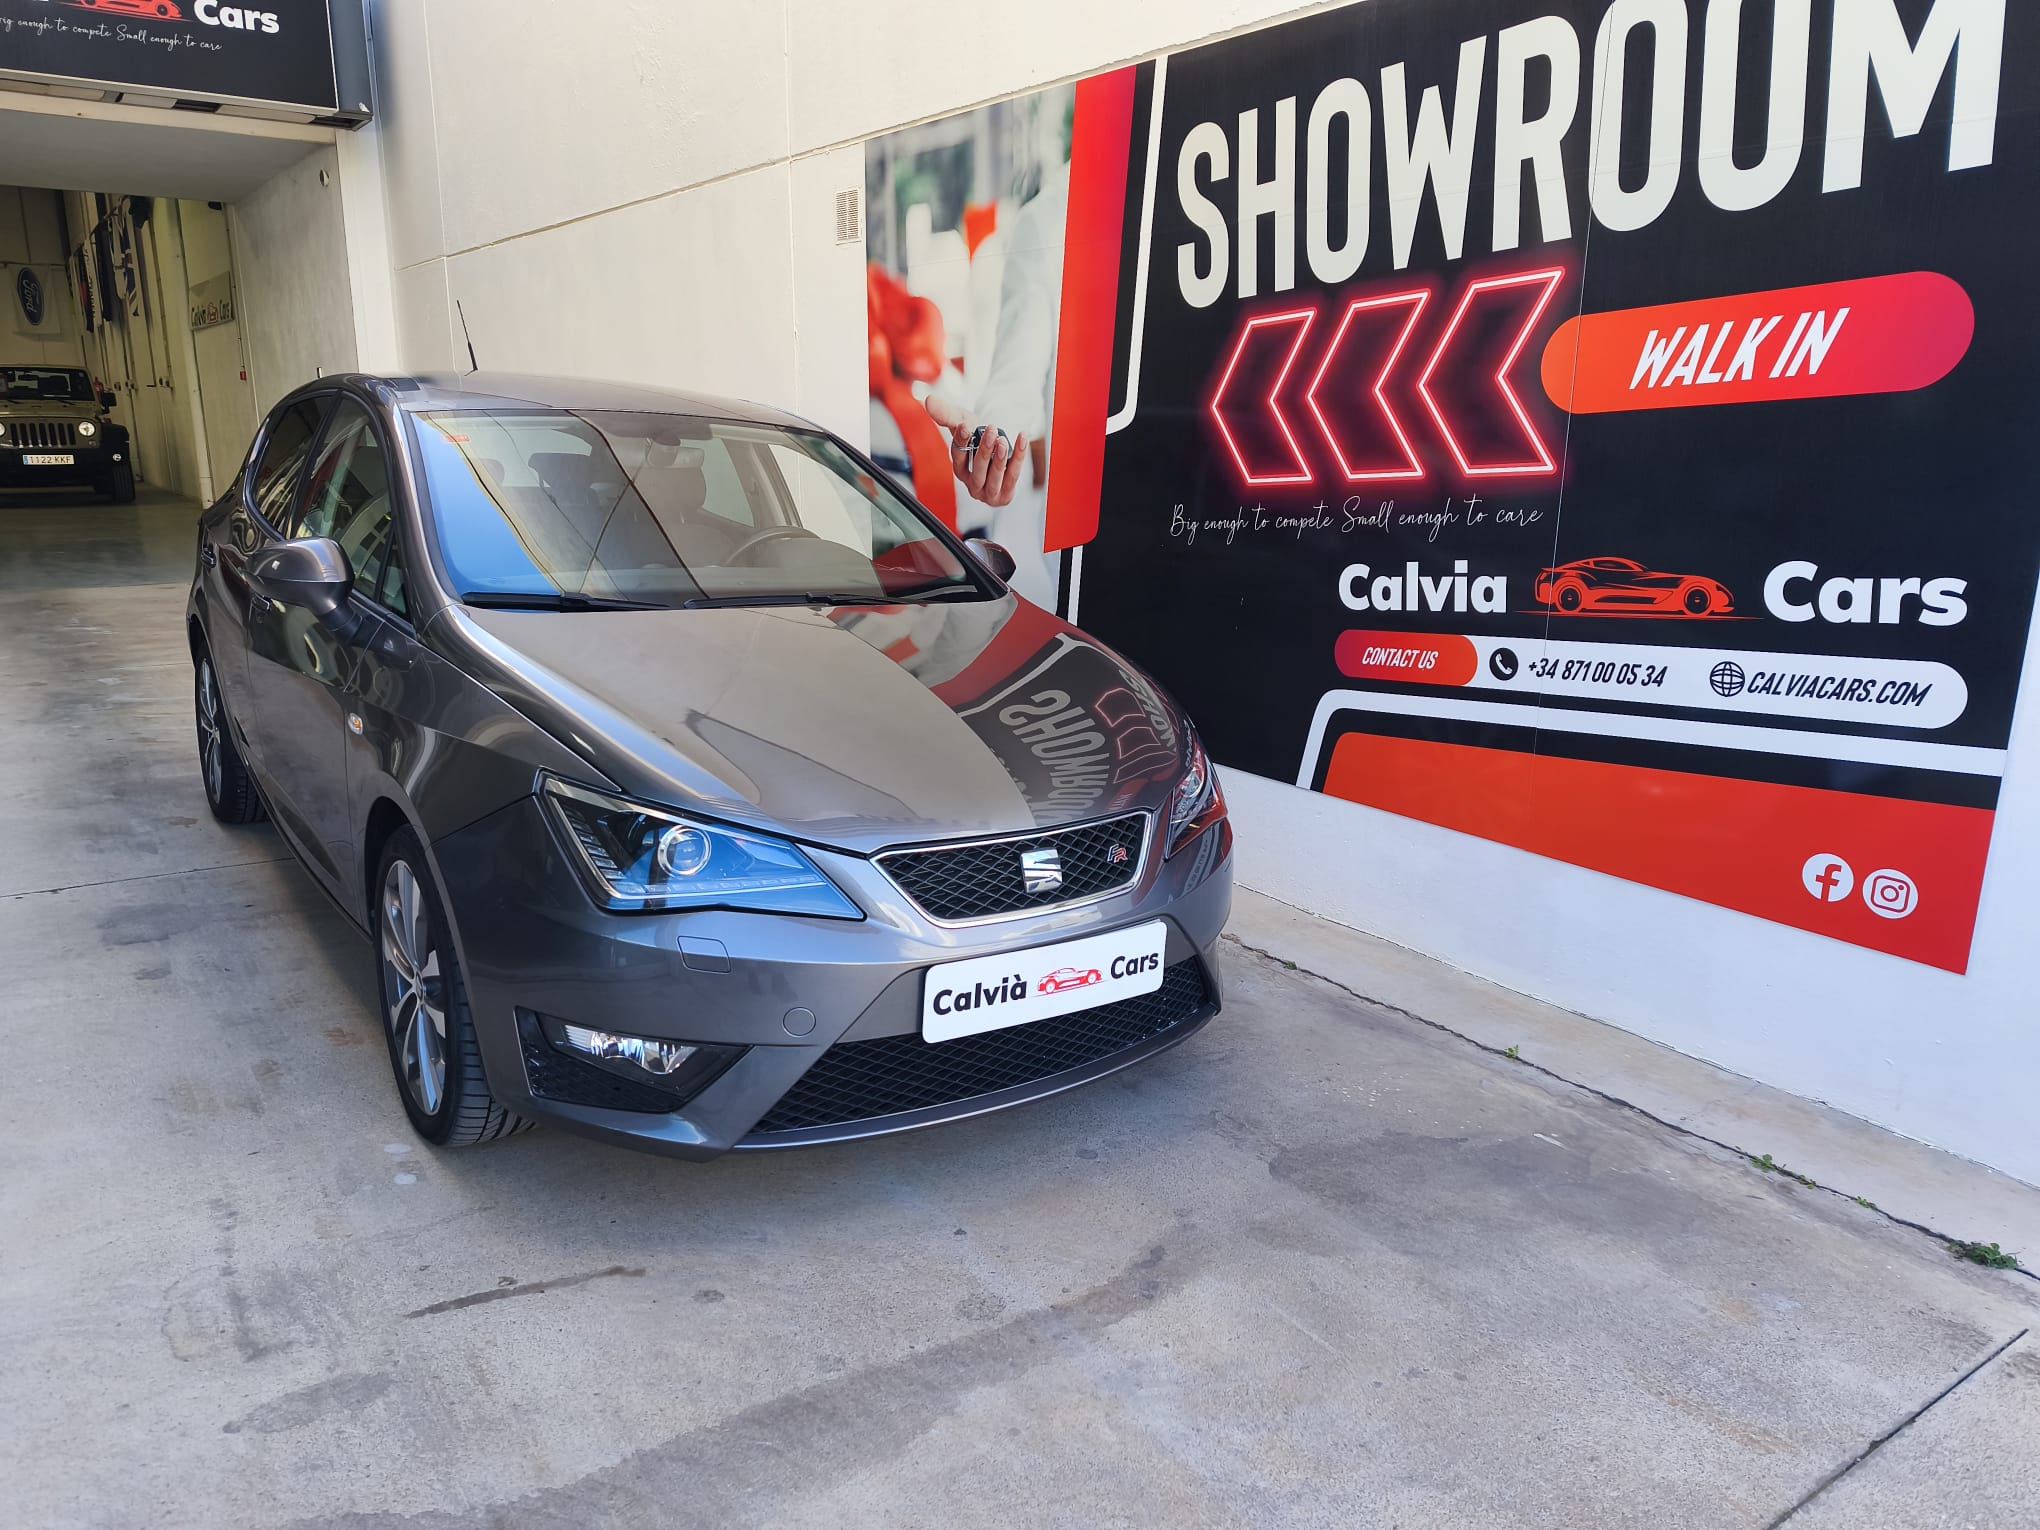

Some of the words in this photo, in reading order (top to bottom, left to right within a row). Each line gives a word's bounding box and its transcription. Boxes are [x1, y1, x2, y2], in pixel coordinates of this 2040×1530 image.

[0, 17, 14, 32] ig
[18, 17, 53, 36] enough
[55, 17, 68, 31] to
[73, 23, 112, 40] compete
[116, 24, 147, 44] Small
[150, 33, 182, 51] enough
[184, 34, 196, 48] to
[199, 40, 222, 51] care
[194, 0, 280, 34] Cars
[1177, 0, 2006, 308] SHOWROOM
[22, 279, 39, 313] Ford
[1629, 315, 1785, 390] WALK
[1768, 307, 1851, 379] IN
[1170, 503, 1200, 546] Big
[1204, 506, 1248, 545] enough
[1251, 502, 1270, 531] to
[1275, 500, 1334, 540] compete
[1341, 495, 1394, 533] Small
[1398, 497, 1459, 543] enough
[1463, 493, 1489, 526] to
[1495, 508, 1544, 527] care
[1338, 560, 1508, 614] Calvia
[1763, 560, 1969, 626] Cars
[1361, 647, 1420, 669] CONTACT
[1418, 650, 1439, 670] US
[1528, 657, 1557, 679] +34
[1561, 659, 1591, 682] 871
[1591, 661, 1615, 684] 00
[1616, 663, 1642, 685] 05
[1641, 665, 1668, 687] 34
[1747, 671, 1933, 707] CALVIACARS.COM
[1108, 844, 1128, 864] FR
[933, 974, 1028, 1016] Calvià
[1110, 952, 1160, 980] Cars
